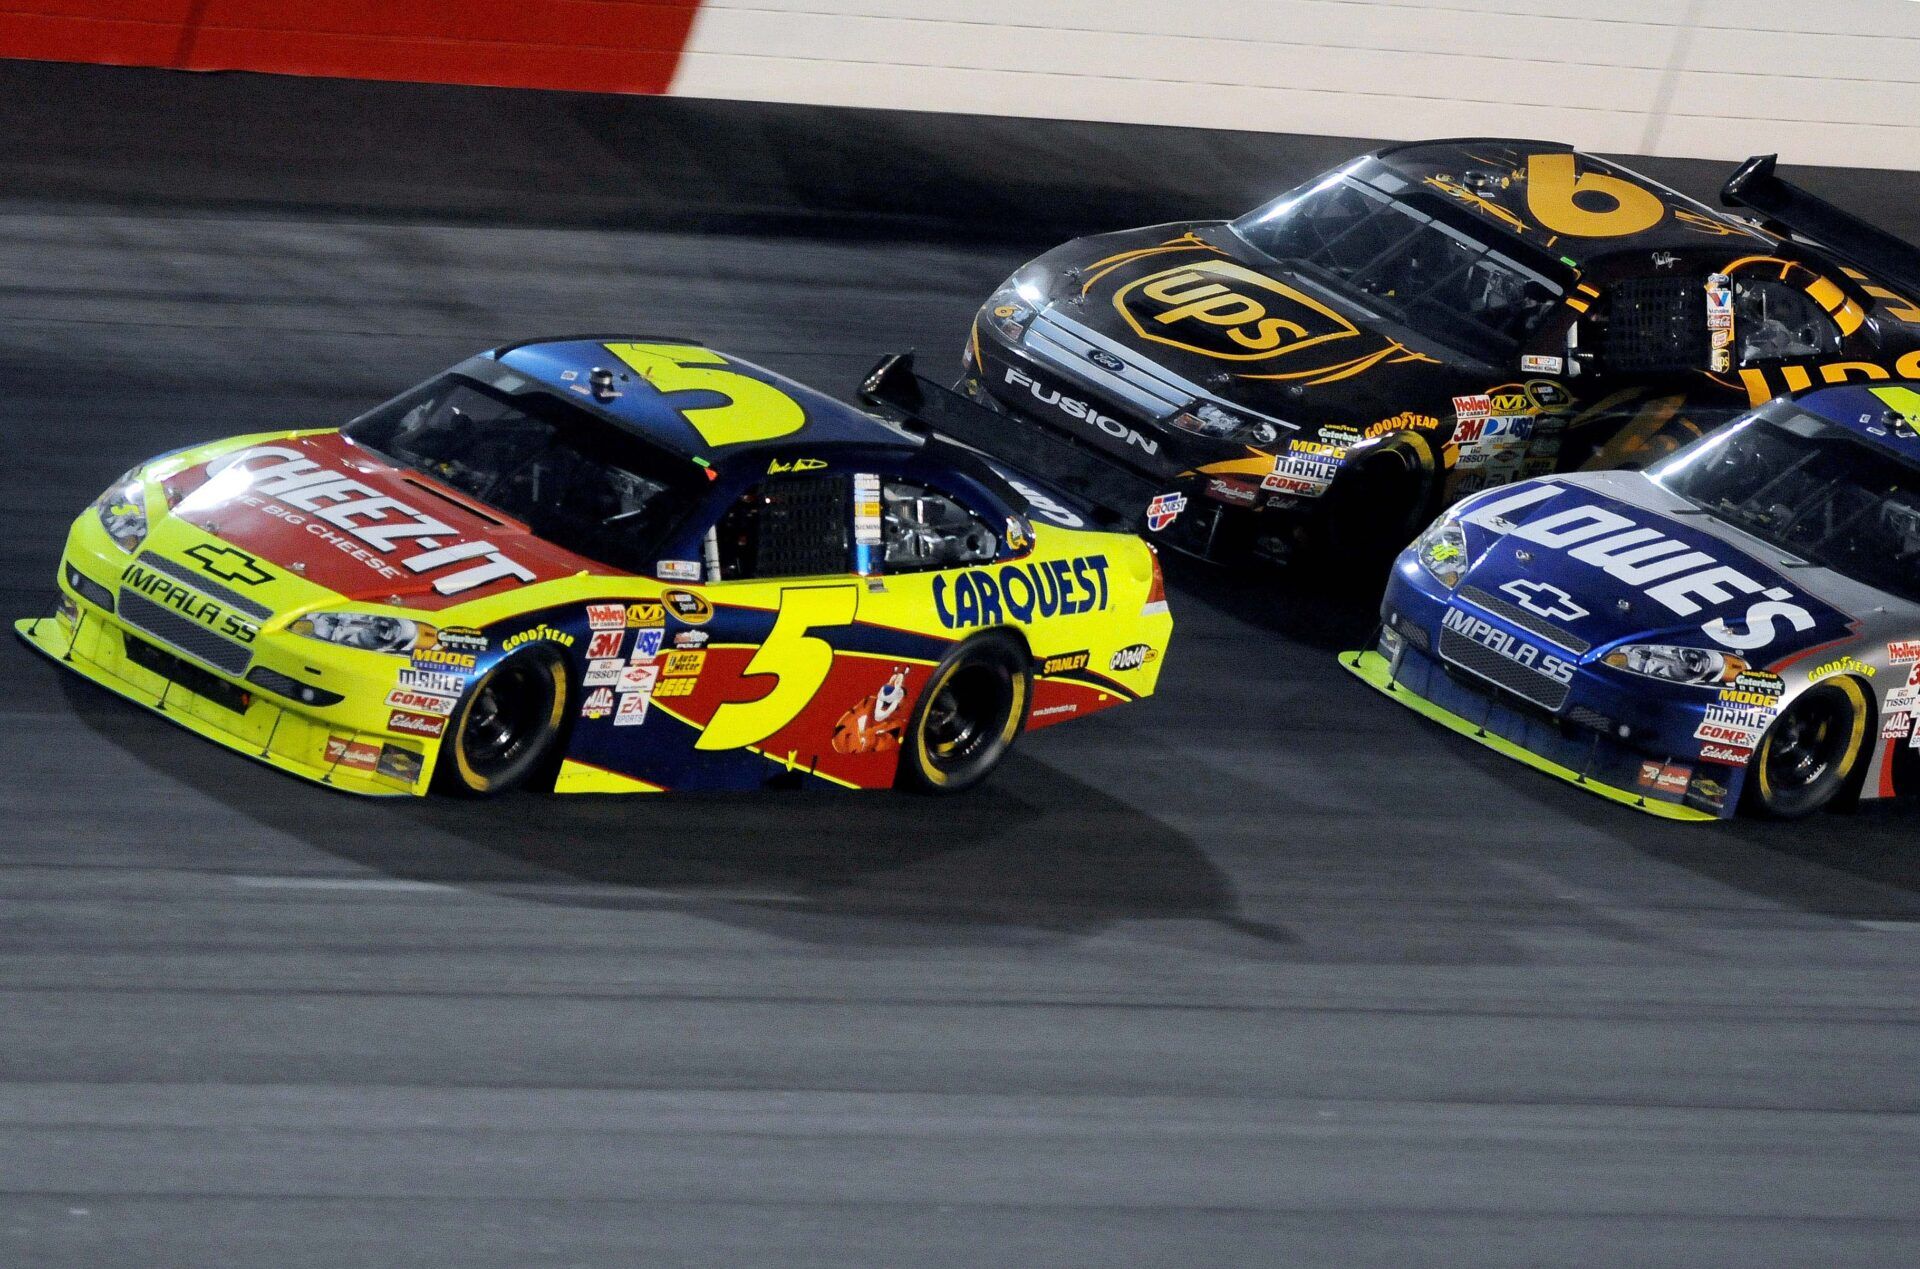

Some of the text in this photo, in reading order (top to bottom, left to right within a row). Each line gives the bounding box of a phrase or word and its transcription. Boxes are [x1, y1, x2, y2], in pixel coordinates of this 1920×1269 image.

[1527, 153, 1665, 237] 6
[1093, 352, 1121, 369] Ford
[602, 343, 806, 448] 5
[1004, 368, 1159, 456] FUSION
[1453, 396, 1490, 415] Holley
[1318, 428, 1363, 442] Gatorback
[1454, 418, 1486, 442] 3M
[1509, 416, 1534, 441] USG
[1458, 454, 1490, 463] TISSOT
[1275, 457, 1336, 480] MAHLE
[1265, 476, 1310, 490] COMP
[1148, 499, 1186, 517] CARQUEST
[205, 446, 537, 597] CHEEZ-IT
[262, 505, 402, 580] BIG CHEESE
[1458, 485, 1816, 650] LOWE'S
[932, 554, 1109, 629] CARQUEST
[121, 564, 261, 643] IMPALA SS
[588, 605, 625, 626] Holley
[589, 632, 623, 657] 3M
[636, 631, 662, 657] USG
[1441, 606, 1577, 683] IMPALA SS
[411, 649, 476, 668] MOOG
[679, 654, 699, 662] Auto
[695, 584, 859, 751] 5
[1043, 654, 1088, 674] STANLEY
[399, 669, 464, 693] MAHLE
[588, 670, 620, 679] TISSOT
[1736, 675, 1784, 691] Gatorback
[652, 678, 698, 697] JEGS
[391, 692, 440, 707] COMP
[582, 687, 613, 708] MAC
[621, 696, 643, 714] EA
[1719, 689, 1778, 708] MOOG
[1886, 697, 1915, 707] TISSOT
[389, 715, 441, 734] Edelbrock
[1706, 704, 1766, 729] MAHLE
[1882, 712, 1911, 731] MAC
[1699, 725, 1746, 741] COMP
[1881, 730, 1909, 739] TOOLS
[1700, 746, 1750, 764] Edelbrock
